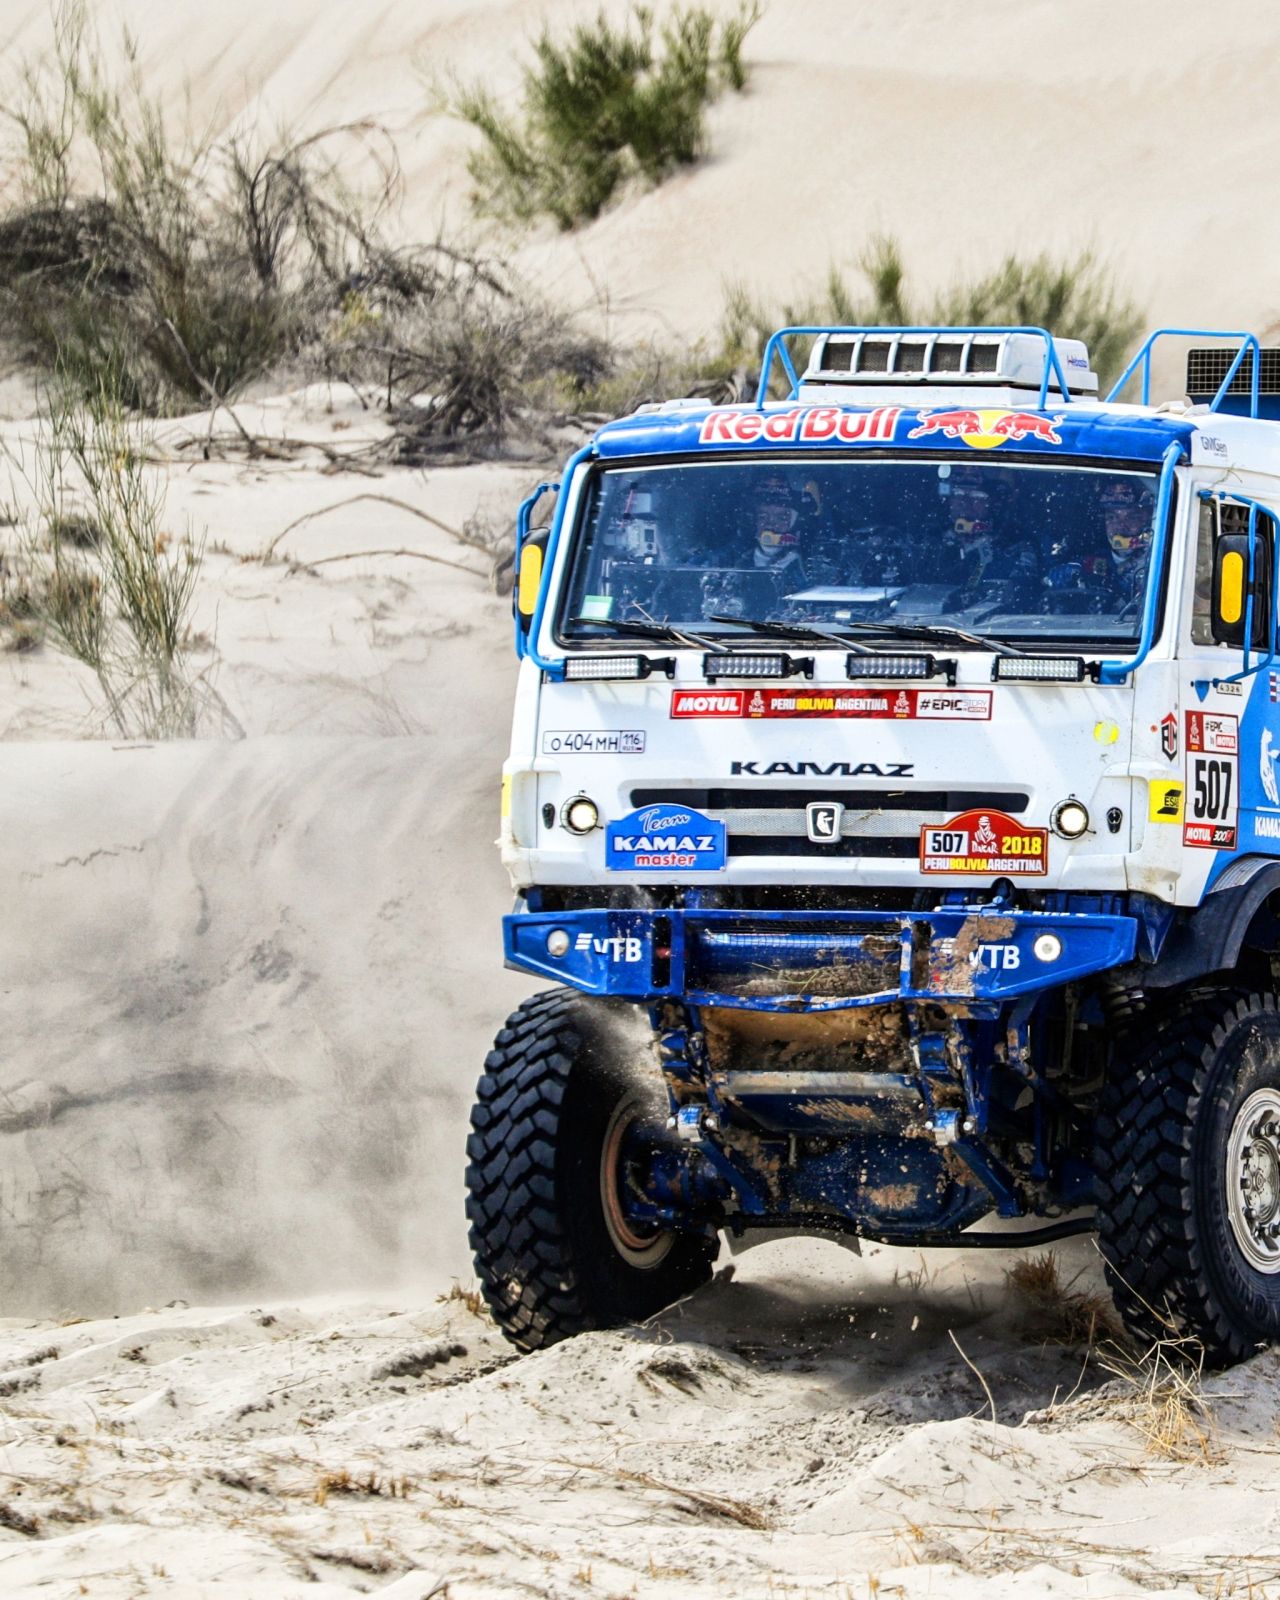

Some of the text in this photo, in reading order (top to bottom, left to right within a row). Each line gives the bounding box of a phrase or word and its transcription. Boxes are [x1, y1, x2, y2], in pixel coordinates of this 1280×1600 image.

[702, 408, 902, 441] Red Bull
[676, 697, 739, 712] MOTUL
[771, 698, 889, 711] PERU BOLIVIA ARGENTINA
[730, 761, 915, 778] KAMAZ
[1194, 759, 1232, 820] 507
[639, 808, 691, 833] Team
[931, 832, 964, 853] 507
[1186, 827, 1213, 841] MOTUL
[613, 836, 715, 852] KAMAZ
[1001, 836, 1042, 855] 2018
[635, 854, 697, 866] master
[592, 937, 643, 963] VTB
